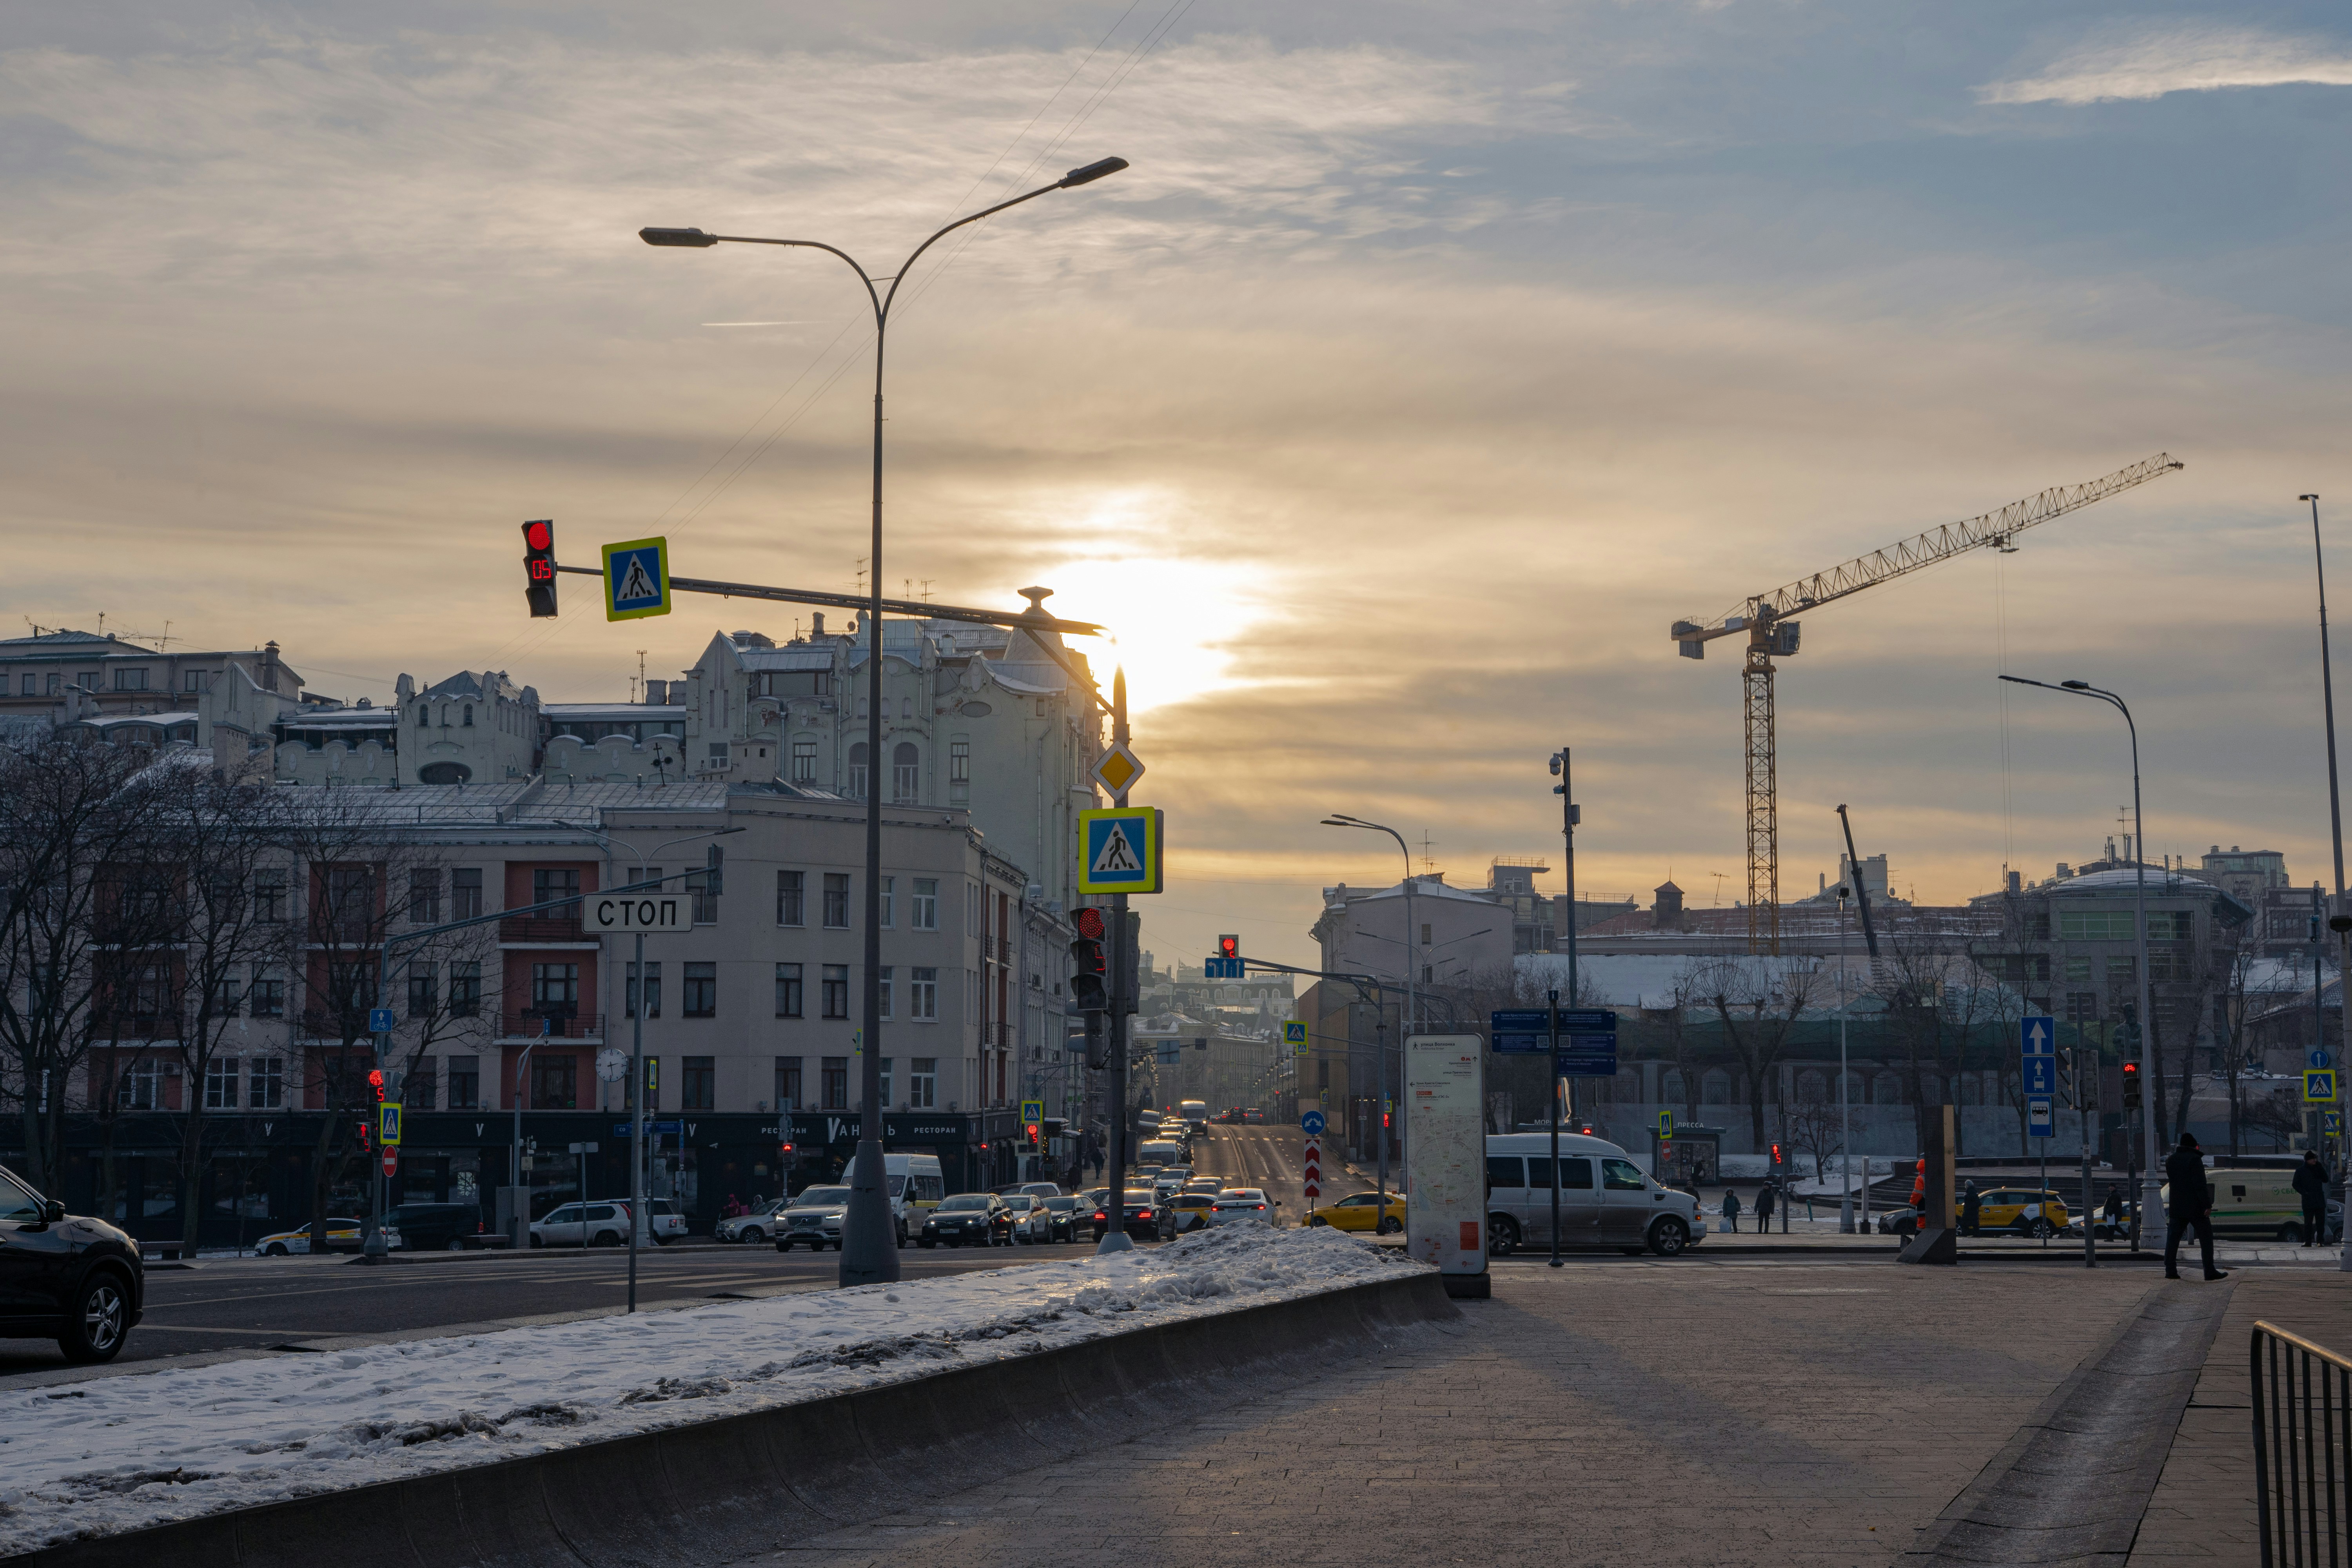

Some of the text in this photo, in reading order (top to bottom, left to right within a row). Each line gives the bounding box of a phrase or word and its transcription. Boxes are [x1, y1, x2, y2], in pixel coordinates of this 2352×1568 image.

[532, 560, 552, 579] 05
[597, 900, 677, 926] СТОП
[1095, 945, 1106, 971] 5
[377, 1087, 384, 1101] 5
[1033, 1134, 1037, 1143] 5
[1776, 1154, 1781, 1163] 5
